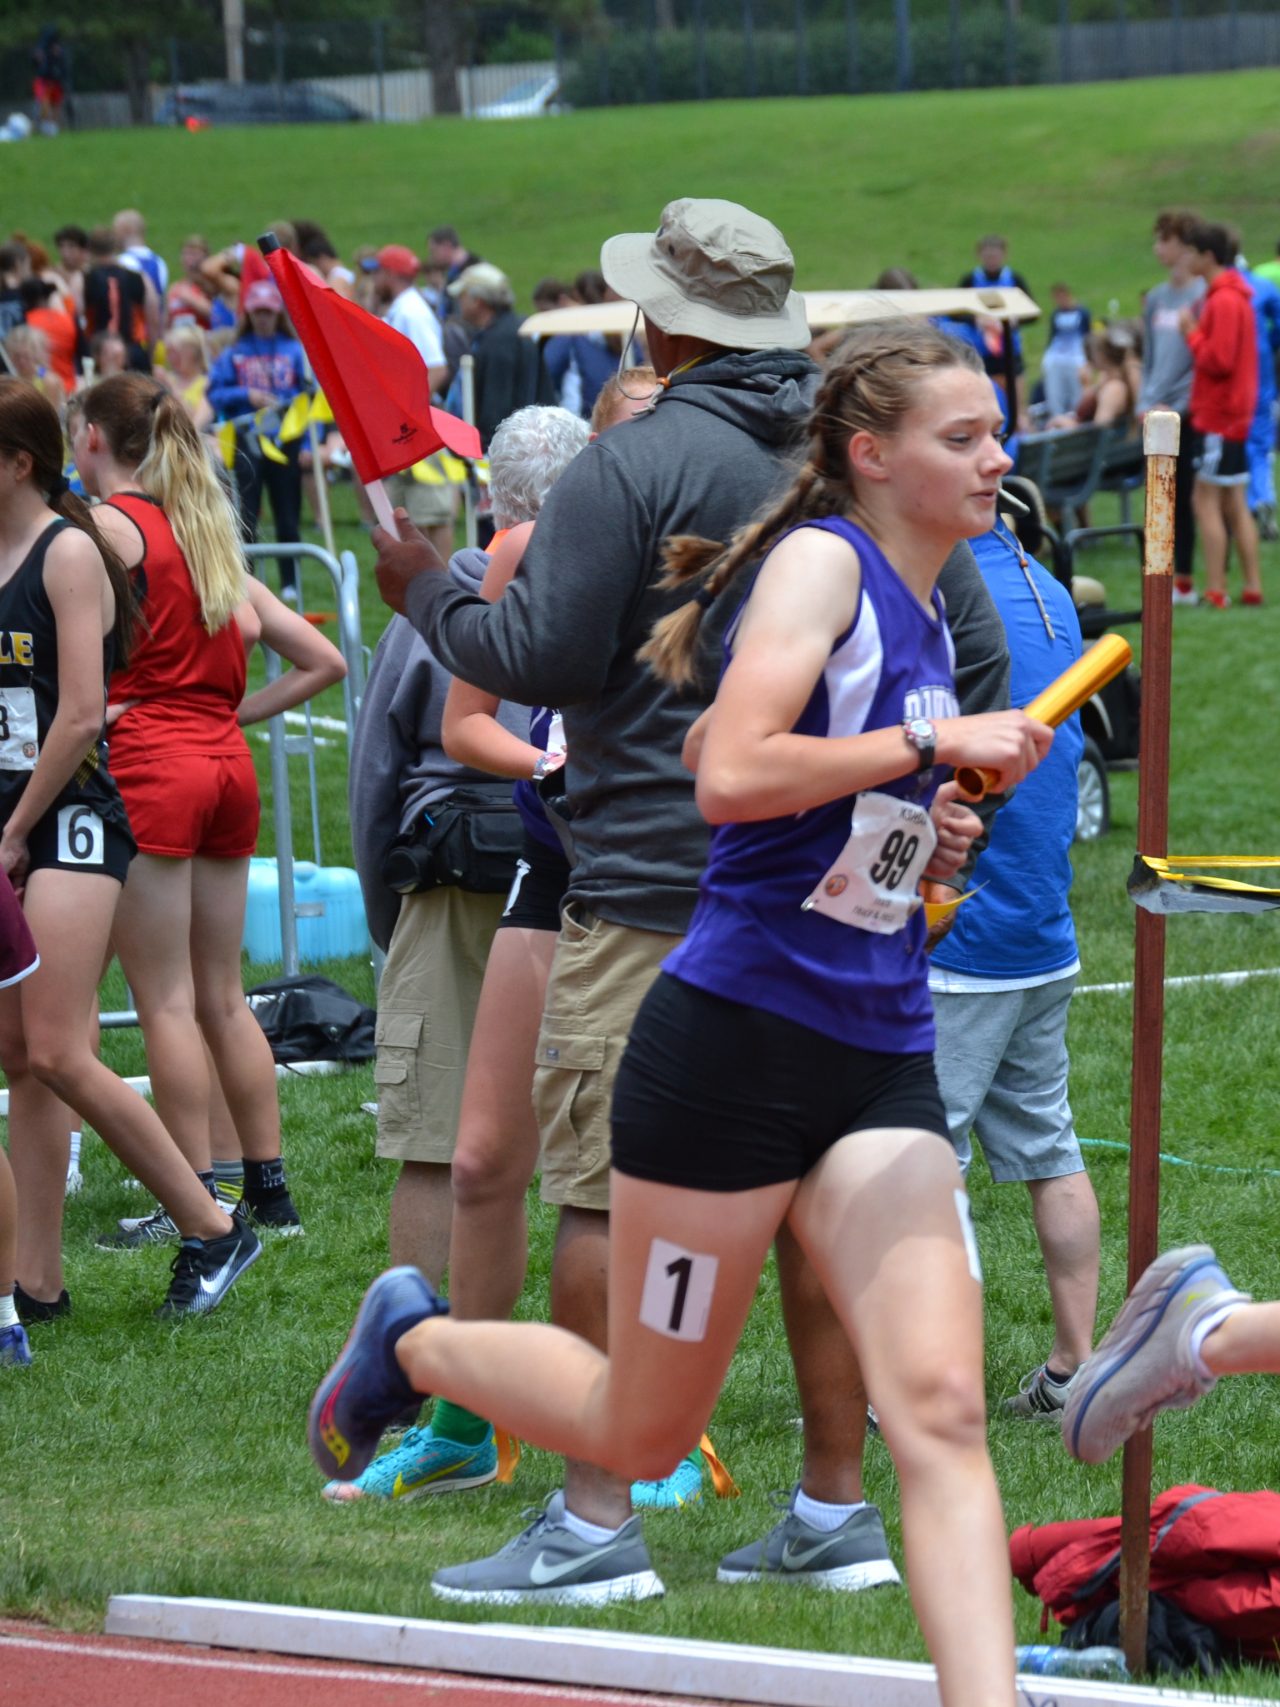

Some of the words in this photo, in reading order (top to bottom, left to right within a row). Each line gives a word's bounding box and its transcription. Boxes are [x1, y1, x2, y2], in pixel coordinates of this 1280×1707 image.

[67, 807, 94, 860] 6
[869, 829, 920, 892] 99
[665, 1256, 694, 1333] 1
